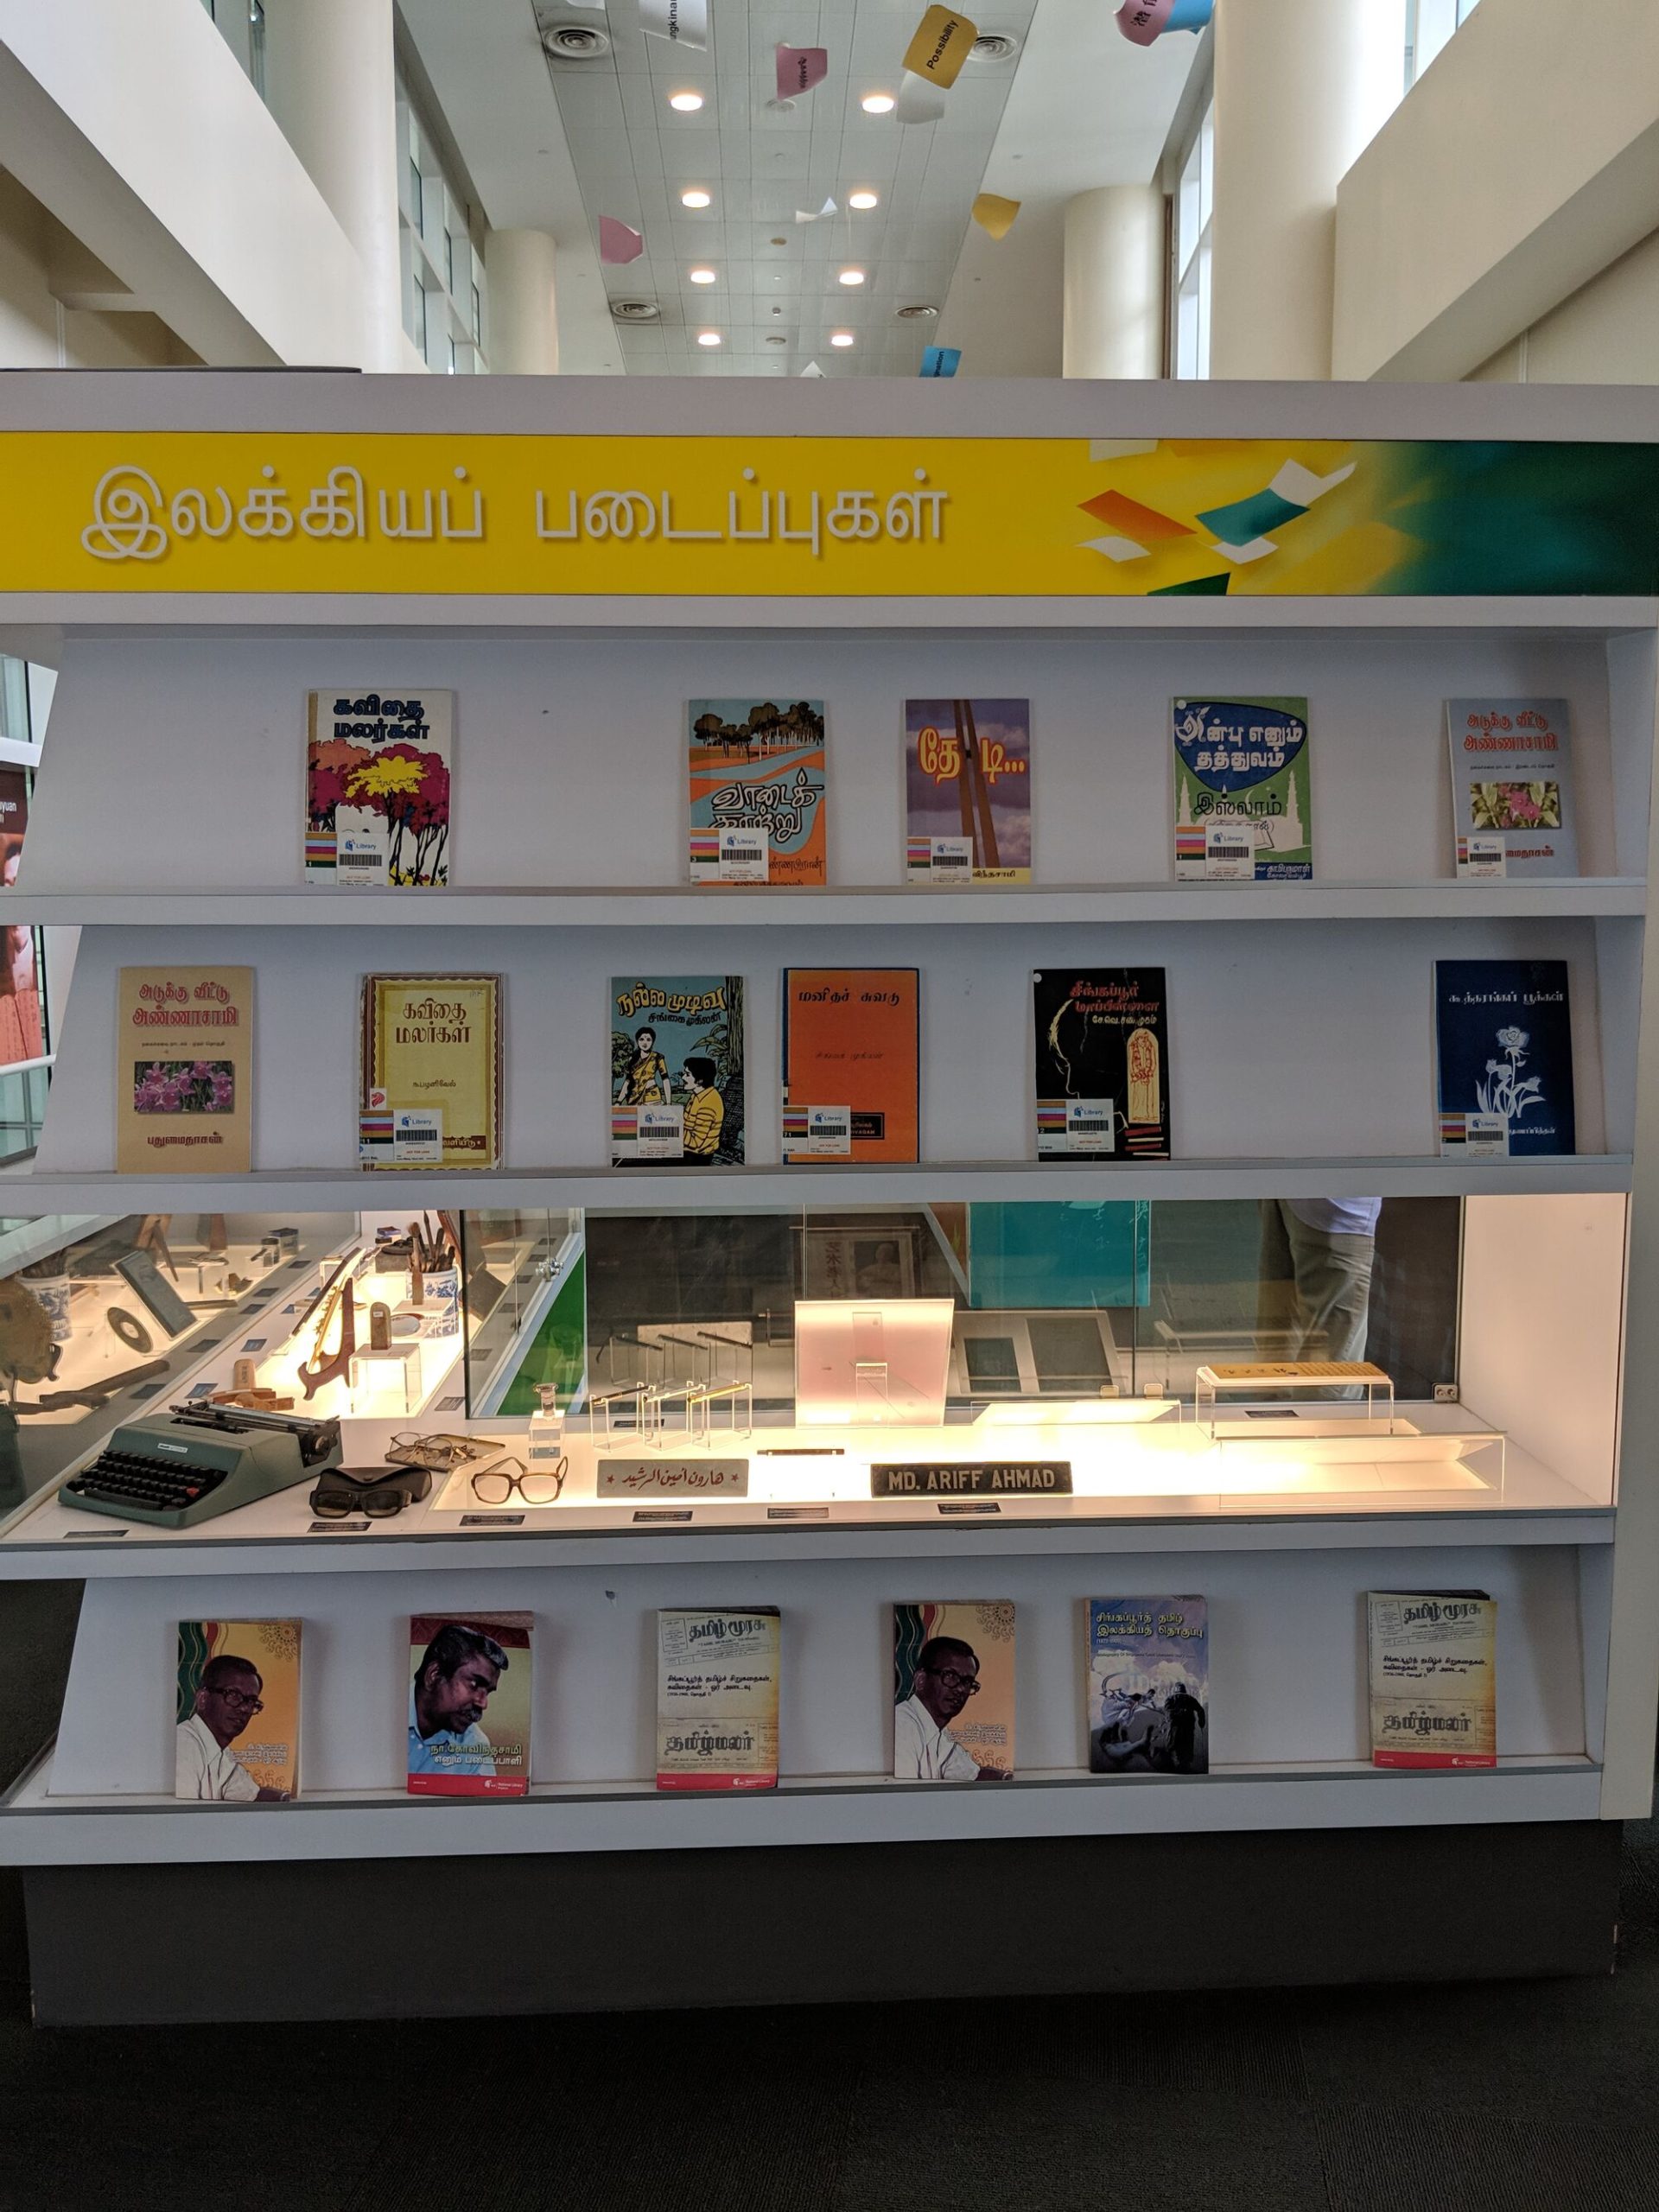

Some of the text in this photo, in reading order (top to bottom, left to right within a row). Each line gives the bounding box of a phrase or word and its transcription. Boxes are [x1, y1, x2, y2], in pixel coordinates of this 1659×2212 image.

[668, 0, 679, 40] ungkina
[926, 20, 959, 70] Possibility
[80, 465, 950, 561] இலக்கியப் படைப்புகள்
[334, 694, 425, 722] கவிதை
[334, 718, 430, 743] மலர்கள்
[1249, 719, 1303, 747] எனும்
[1194, 745, 1286, 772] தத்துவம்
[711, 766, 825, 811] வாடைக்
[1193, 791, 1282, 817] இஸ்லாம்
[139, 981, 231, 1004] அடுக்கு வீட்டு
[616, 982, 727, 1018] நல்ல முடிவு
[132, 1004, 239, 1027] அண்ணாசாமி
[403, 997, 467, 1024] கவிதை
[396, 1020, 472, 1044] மலர்கள்
[147, 1131, 224, 1148] புதுமைதாசன்
[888, 1469, 1055, 1491] MD. ARIFF AHMAD
[435, 1755, 461, 1766] எனும்
